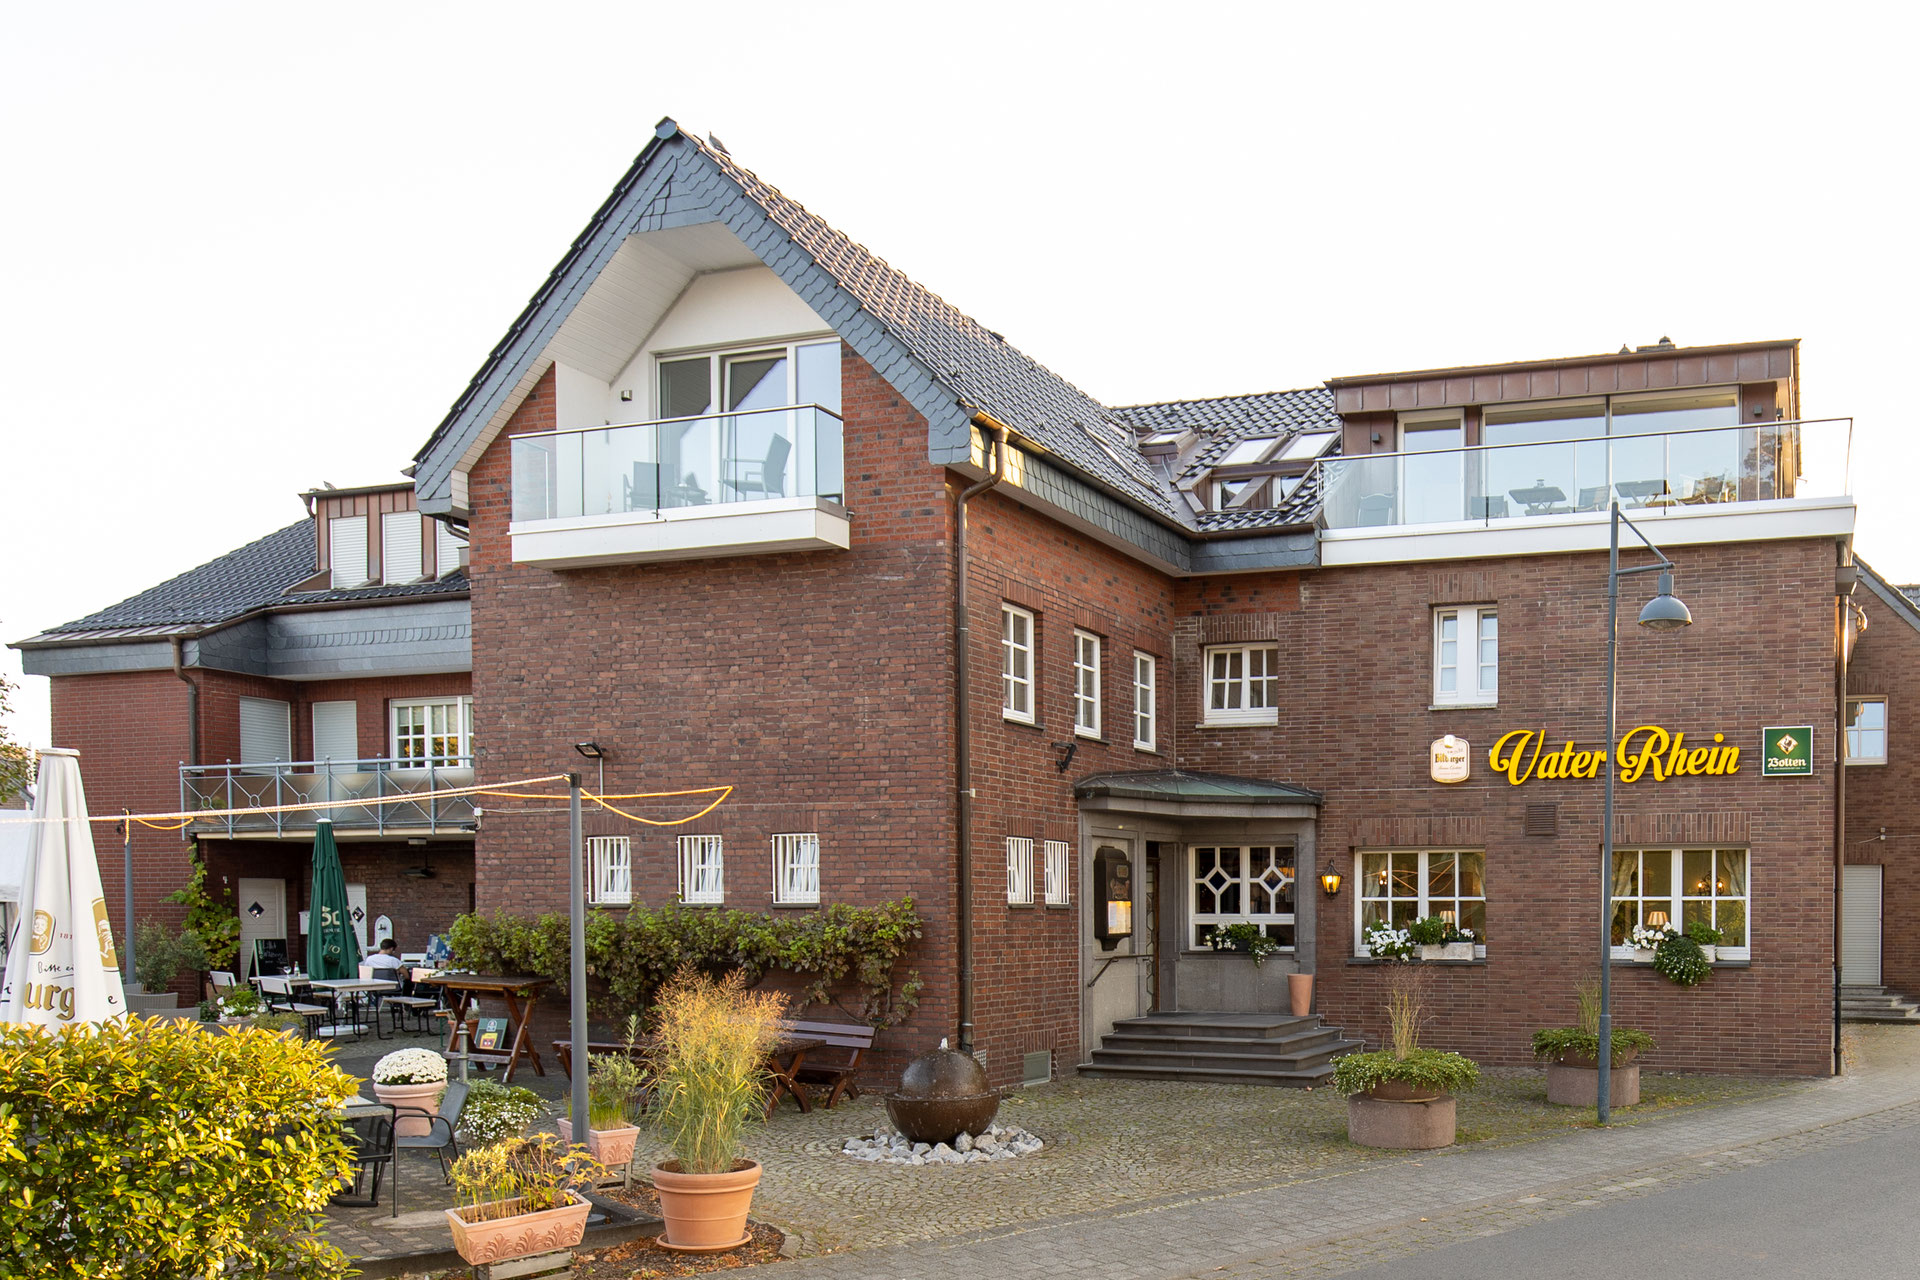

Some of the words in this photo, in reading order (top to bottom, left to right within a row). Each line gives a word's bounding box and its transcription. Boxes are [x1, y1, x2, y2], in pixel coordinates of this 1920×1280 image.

[1489, 729, 1607, 786] Vater
[1616, 725, 1741, 783] Rhein
[1767, 757, 1807, 768] Bolten
